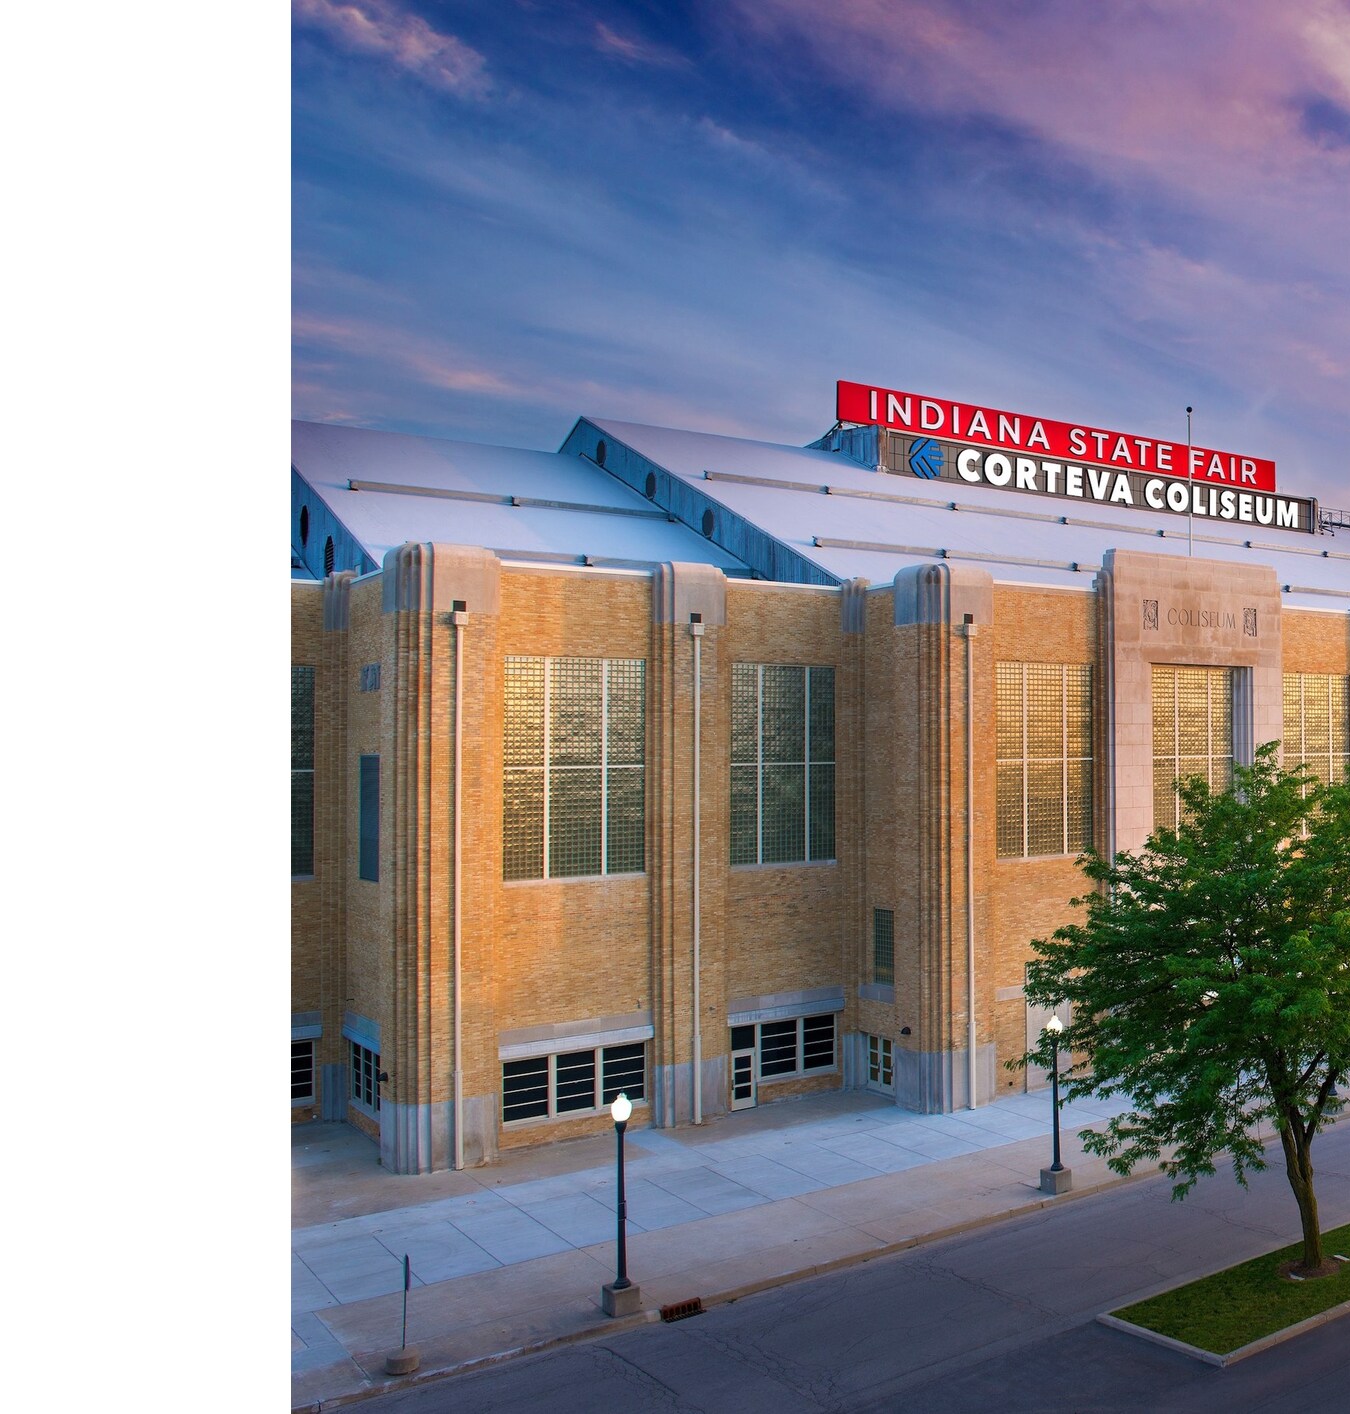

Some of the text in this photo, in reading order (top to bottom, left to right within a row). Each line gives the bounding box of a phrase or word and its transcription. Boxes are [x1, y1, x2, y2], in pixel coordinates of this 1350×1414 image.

[869, 390, 1257, 485] INDIANA STATE FAIR
[957, 449, 1299, 529] CORTEVA COLISEUM
[1167, 607, 1236, 630] COLISEUM
